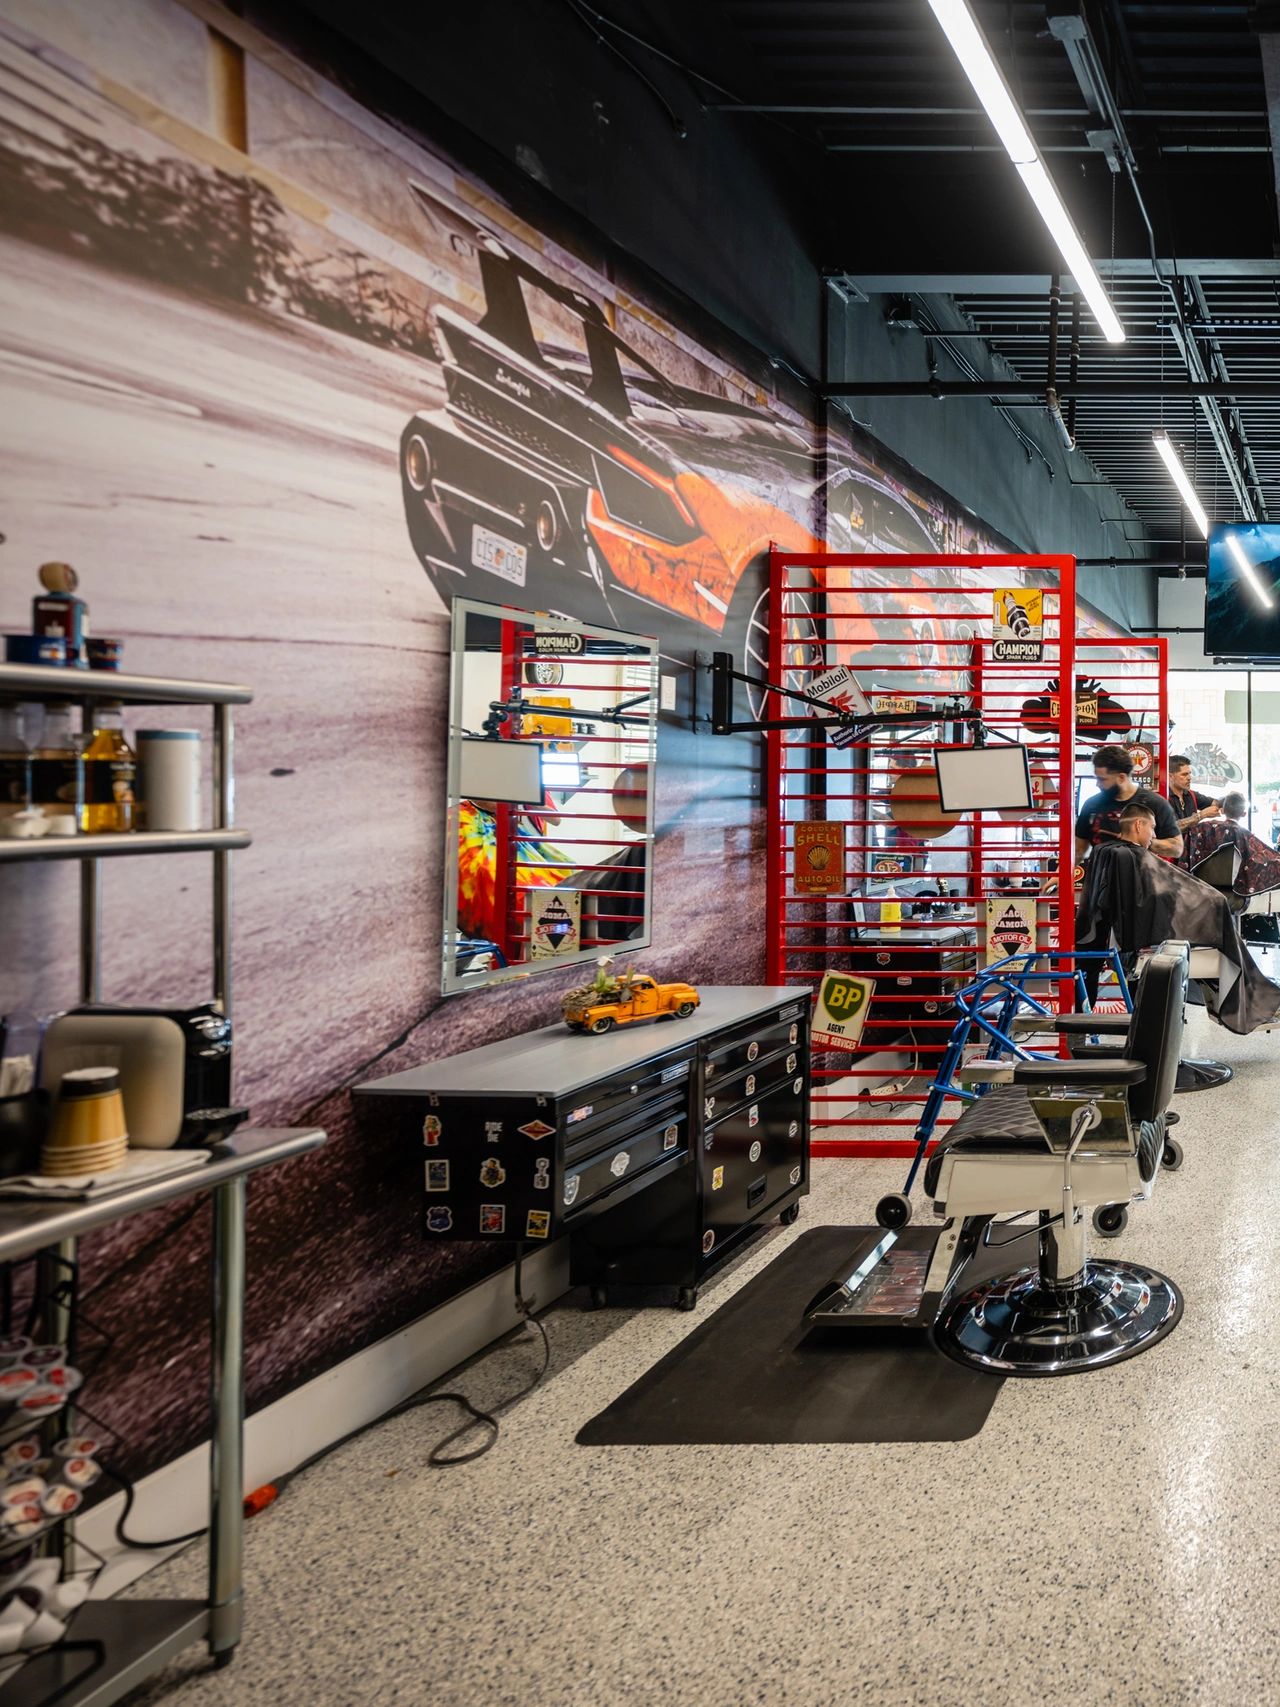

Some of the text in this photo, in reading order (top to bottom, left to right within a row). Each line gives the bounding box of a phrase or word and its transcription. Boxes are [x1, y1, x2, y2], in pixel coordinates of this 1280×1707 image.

[993, 640, 1040, 659] CHAMPION
[806, 668, 848, 698] Mobiloil
[797, 833, 840, 847] SHELL
[798, 875, 840, 883] AUTO OIL
[997, 909, 1026, 918] BLACK
[990, 920, 1033, 928] DIAMOND
[993, 934, 1029, 942] MOTOR OIL
[826, 983, 862, 1010] BP
[826, 1022, 846, 1035] AGENT
[811, 1031, 857, 1050] MOTOR SERVICES
